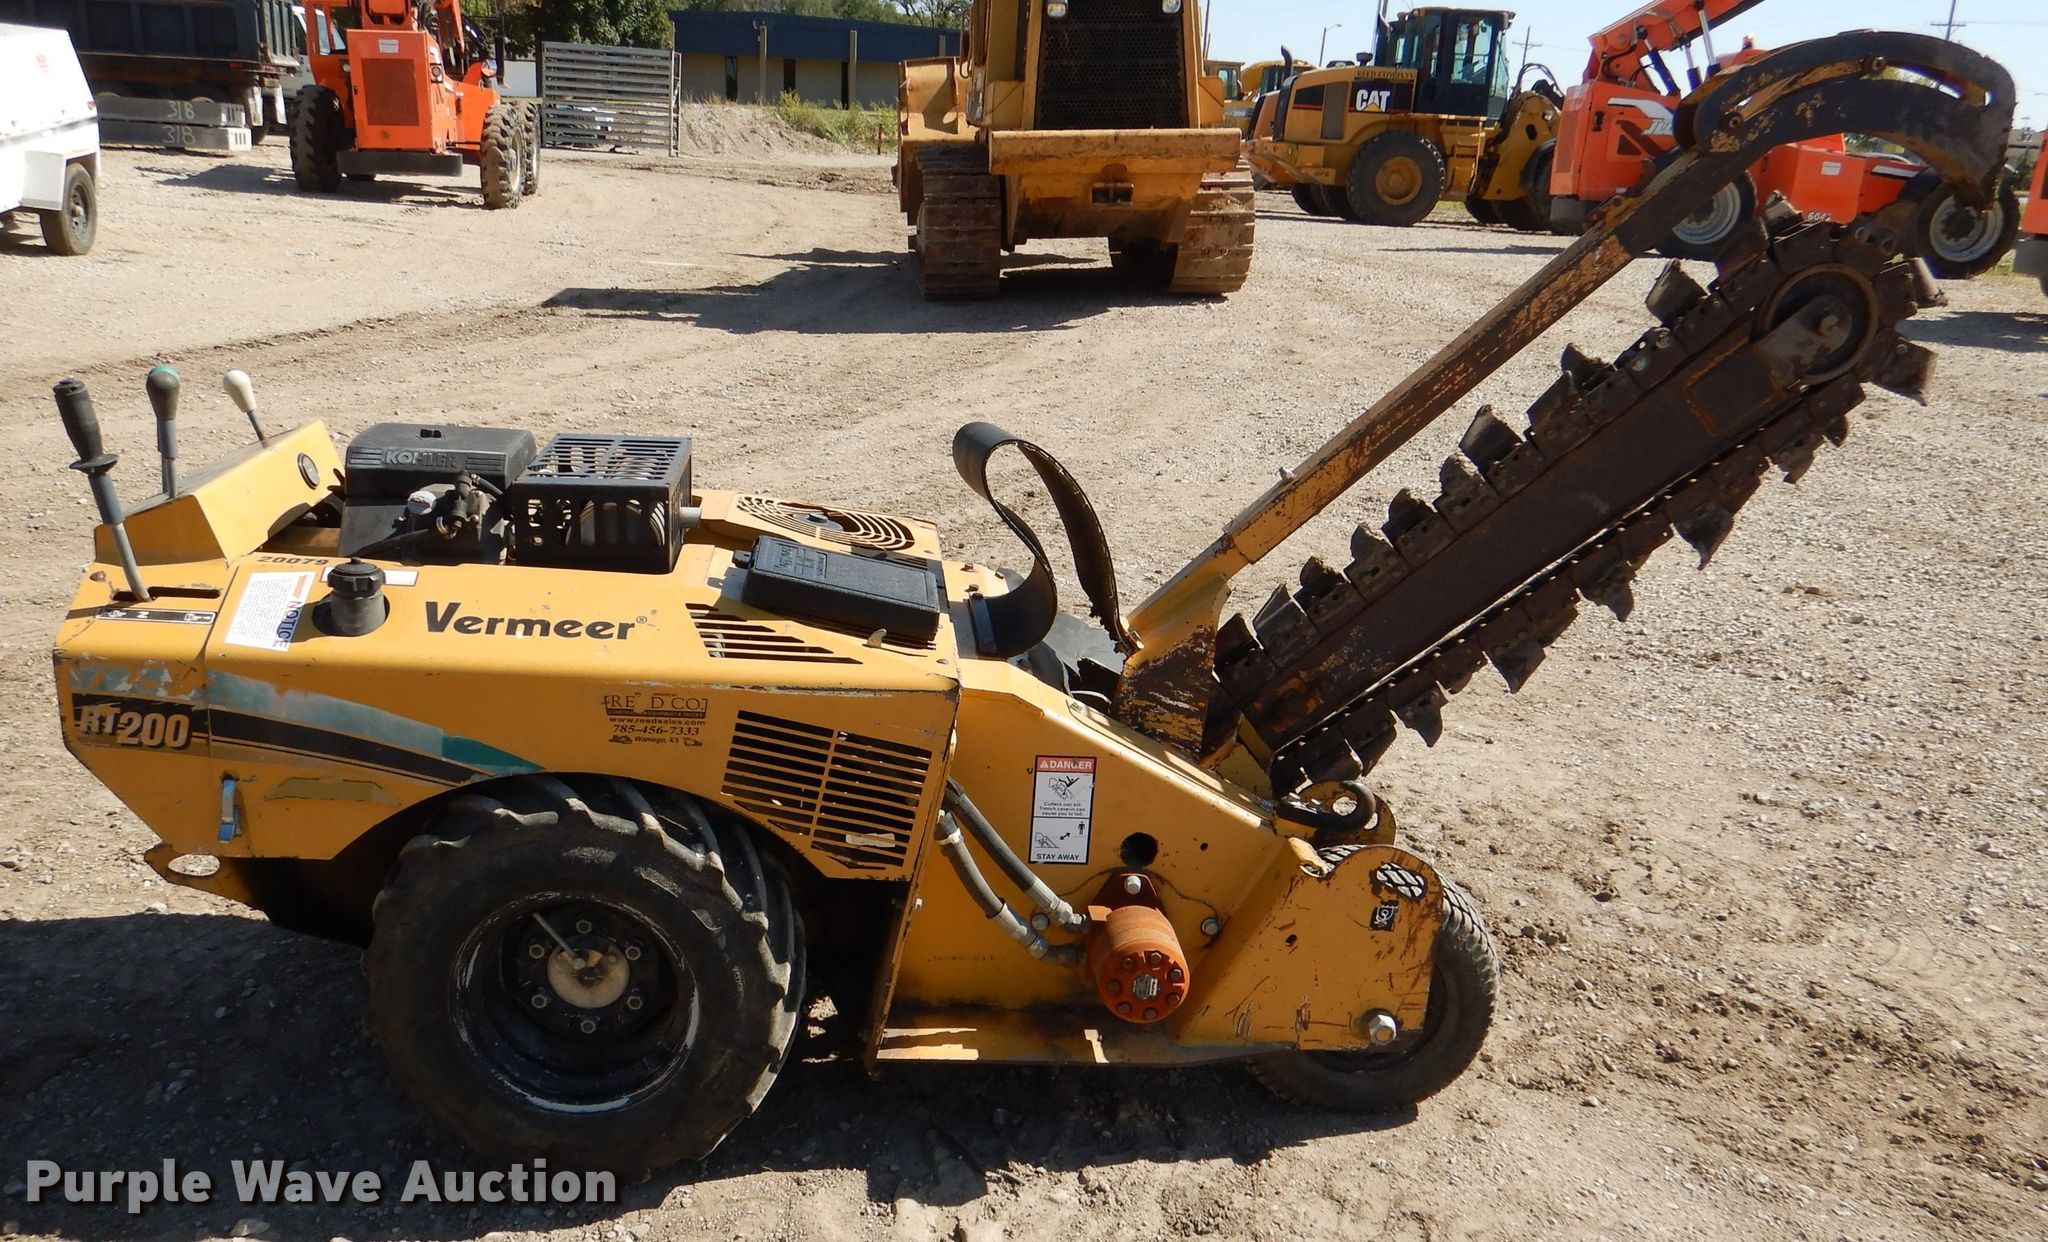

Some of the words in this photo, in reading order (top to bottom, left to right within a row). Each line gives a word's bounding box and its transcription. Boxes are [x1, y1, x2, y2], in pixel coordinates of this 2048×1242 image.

[1356, 89, 1390, 112] CAT
[384, 450, 460, 469] KOHLER
[257, 555, 330, 566] 20079
[272, 600, 304, 648] NOTICE
[611, 694, 665, 709] RED
[609, 717, 706, 726] www.reedsales.com
[613, 724, 700, 736] 785-456-7333
[1050, 760, 1092, 770] DANGER
